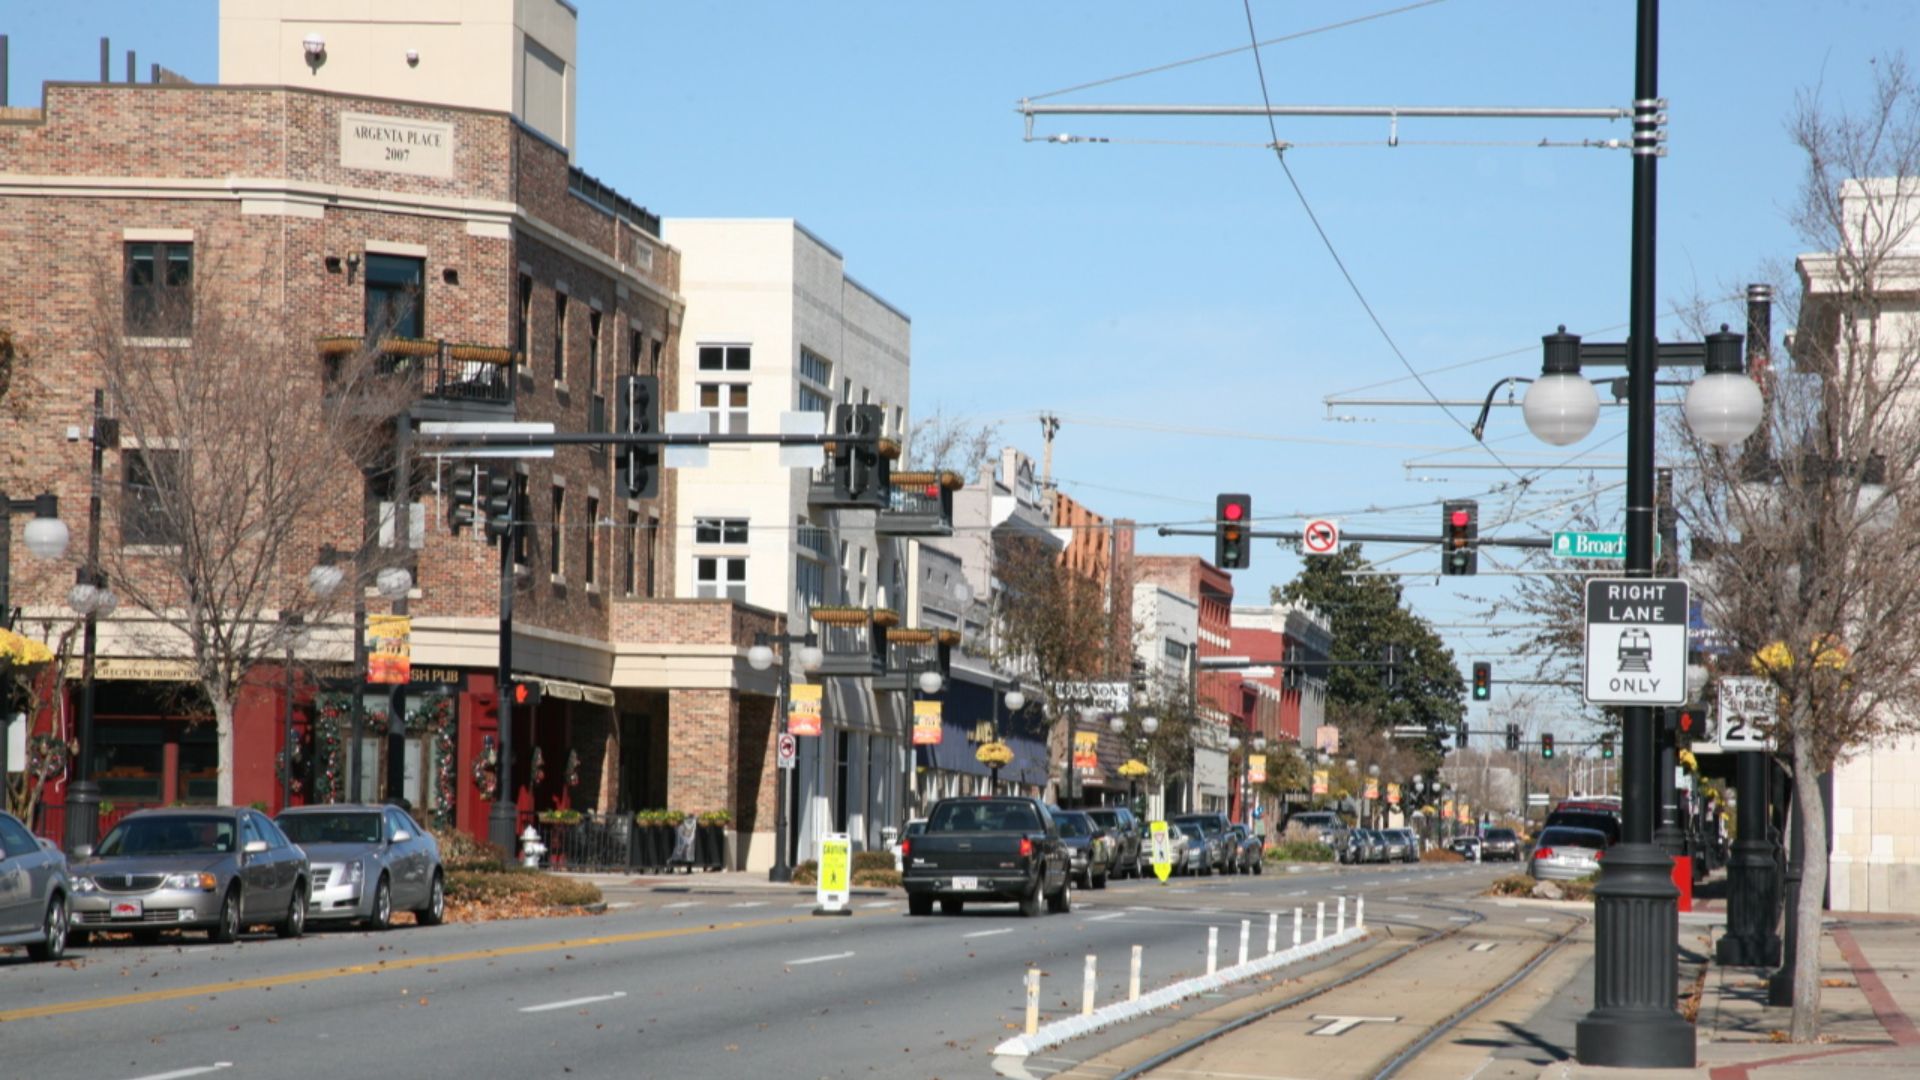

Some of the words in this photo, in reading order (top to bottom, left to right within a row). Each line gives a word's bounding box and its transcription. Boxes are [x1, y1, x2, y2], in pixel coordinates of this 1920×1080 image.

[354, 126, 403, 143] ARGENTA
[407, 131, 442, 148] PLACE
[385, 146, 410, 162] 2007
[1576, 534, 1626, 554] Broad
[1608, 585, 1666, 600] RIGHT
[1609, 606, 1665, 621] LANE
[432, 669, 459, 683] PUB
[1609, 677, 1661, 692] ONLY
[1726, 715, 1770, 741] 25
